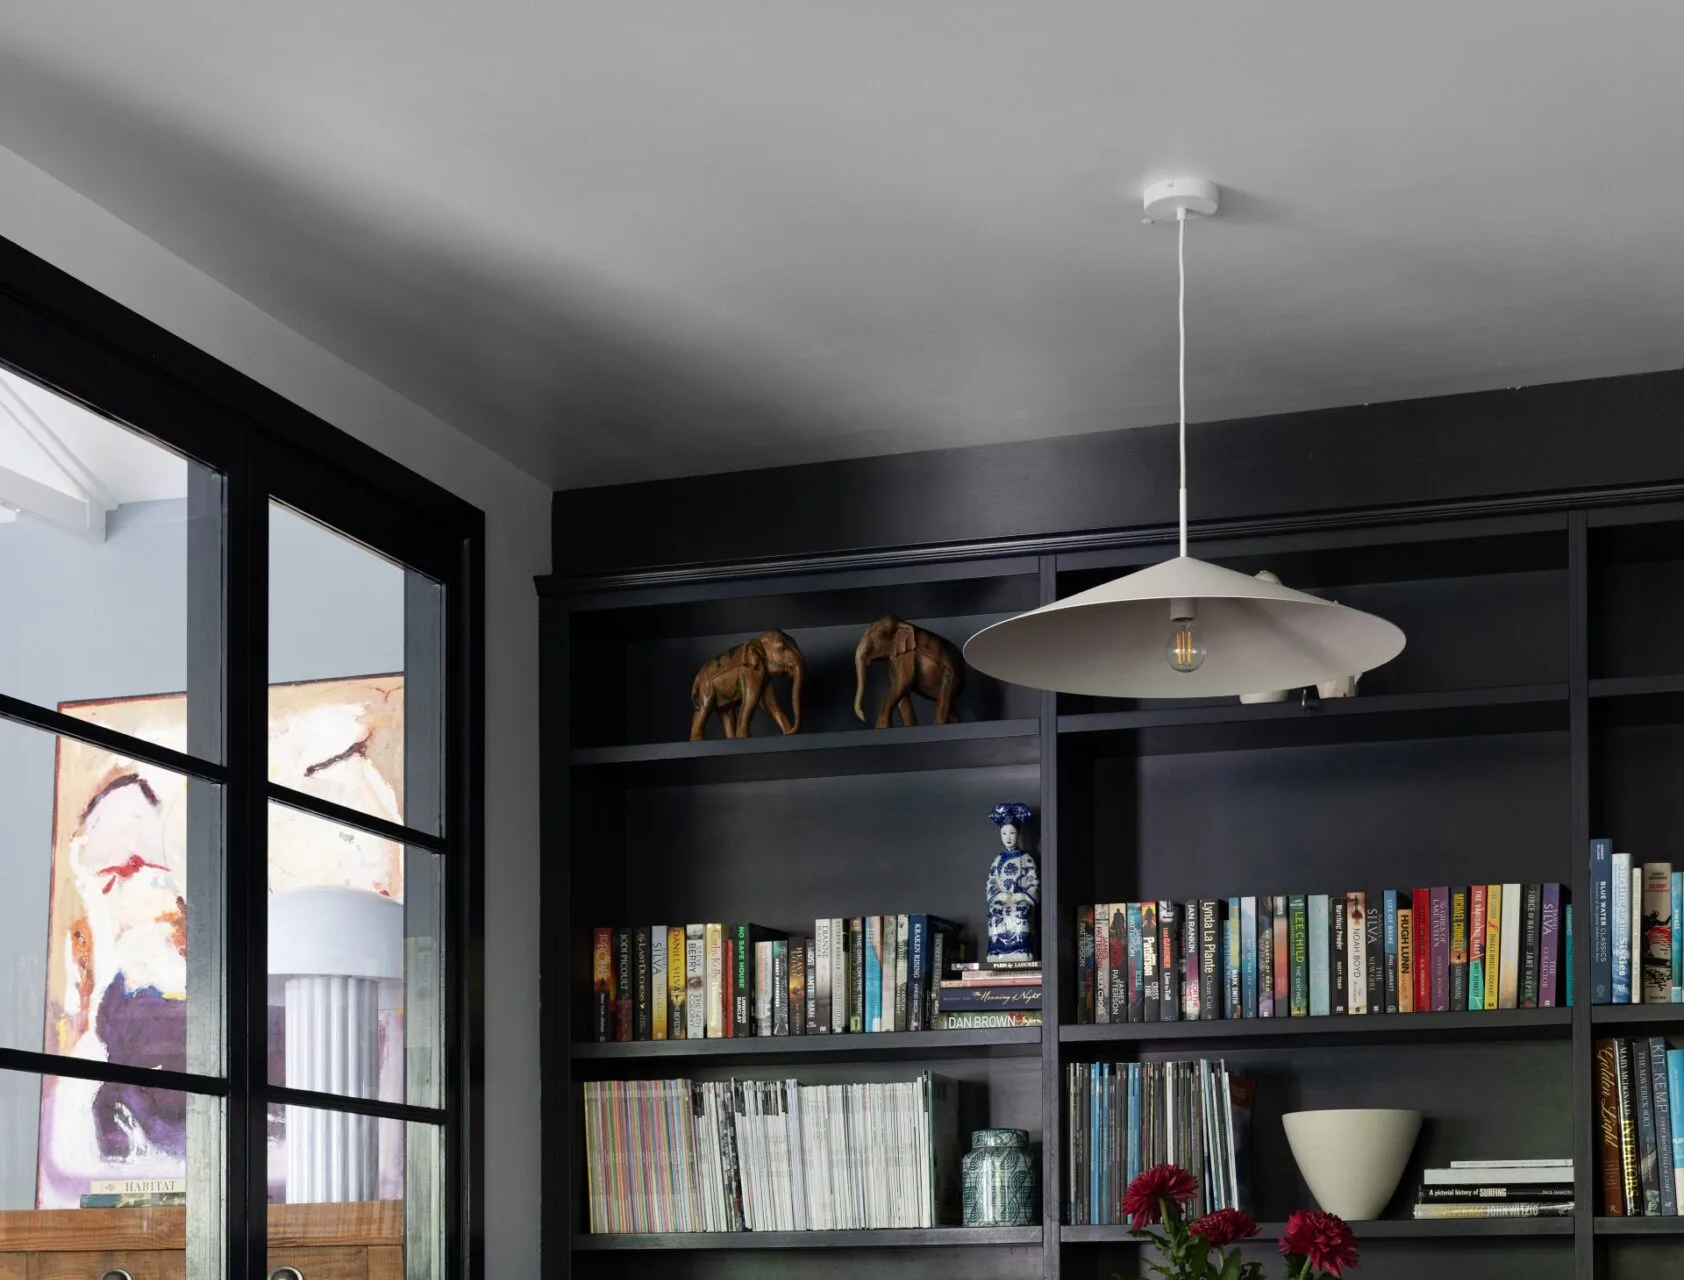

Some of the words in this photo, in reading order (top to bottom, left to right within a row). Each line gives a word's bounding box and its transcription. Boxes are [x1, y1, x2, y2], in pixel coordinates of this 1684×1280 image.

[1202, 902, 1215, 928] Lynda
[1296, 912, 1304, 929] LEE
[1367, 909, 1378, 944] SILVA
[1543, 904, 1553, 935] SILVA
[738, 926, 745, 938] NO
[1204, 931, 1215, 942] La
[1401, 915, 1409, 944] HUGH
[652, 943, 662, 975] SILVA
[688, 943, 696, 972] BERRY
[1204, 944, 1216, 973] Plante
[1296, 932, 1305, 962] CHILD
[1401, 946, 1409, 974] LUNN
[948, 1016, 973, 1029] DAN
[974, 1015, 1016, 1028] BROWN
[1652, 1045, 1666, 1066] KIT
[1597, 1047, 1615, 1097] Golden
[1655, 1072, 1668, 1113] KEMP
[125, 1181, 176, 1192] HABITAT
[1479, 1188, 1507, 1198] SURFING
